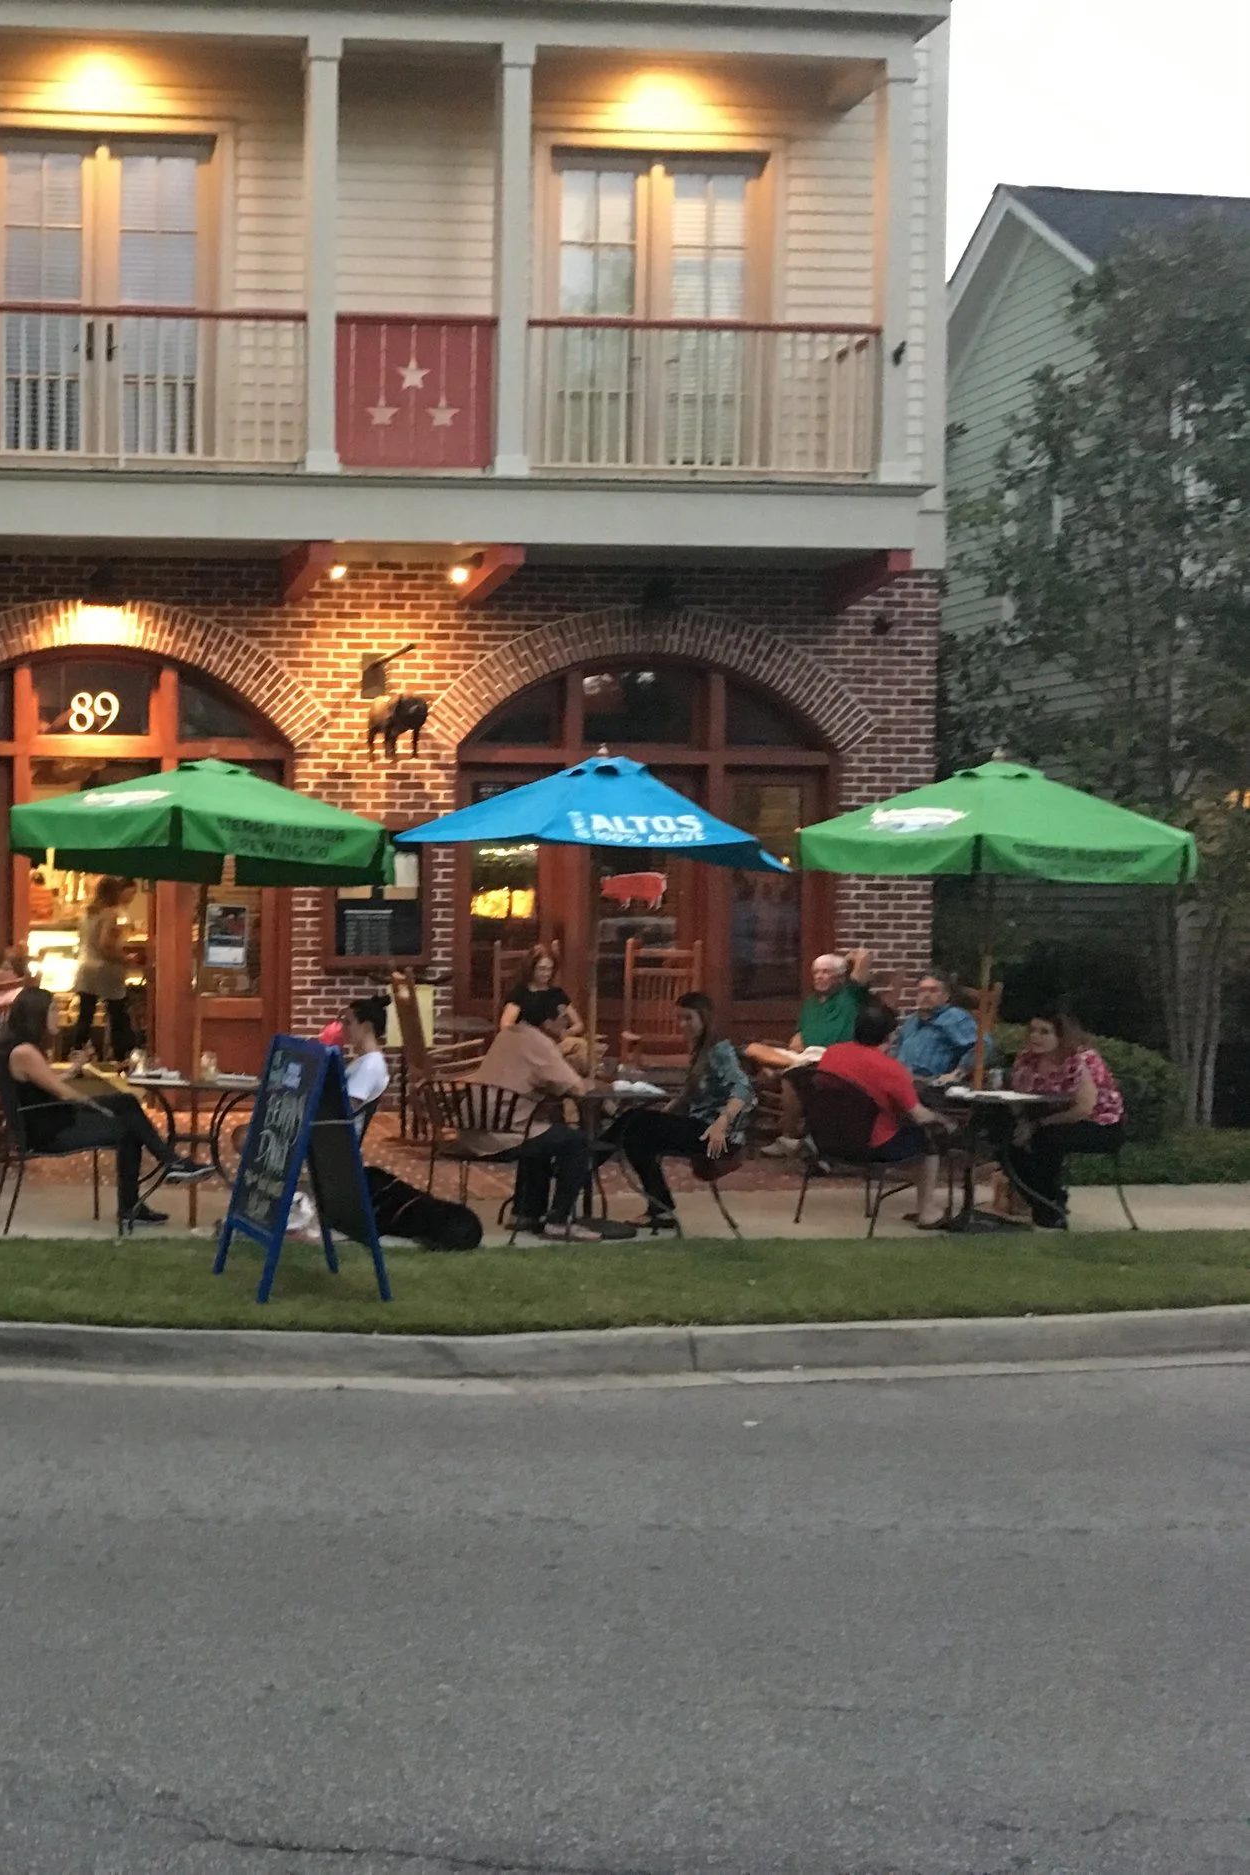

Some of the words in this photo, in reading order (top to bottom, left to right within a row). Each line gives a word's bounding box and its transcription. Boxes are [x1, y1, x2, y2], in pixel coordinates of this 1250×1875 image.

[69, 691, 120, 733] 89
[280, 825, 346, 842] NEVADA
[590, 814, 703, 834] ALTOS
